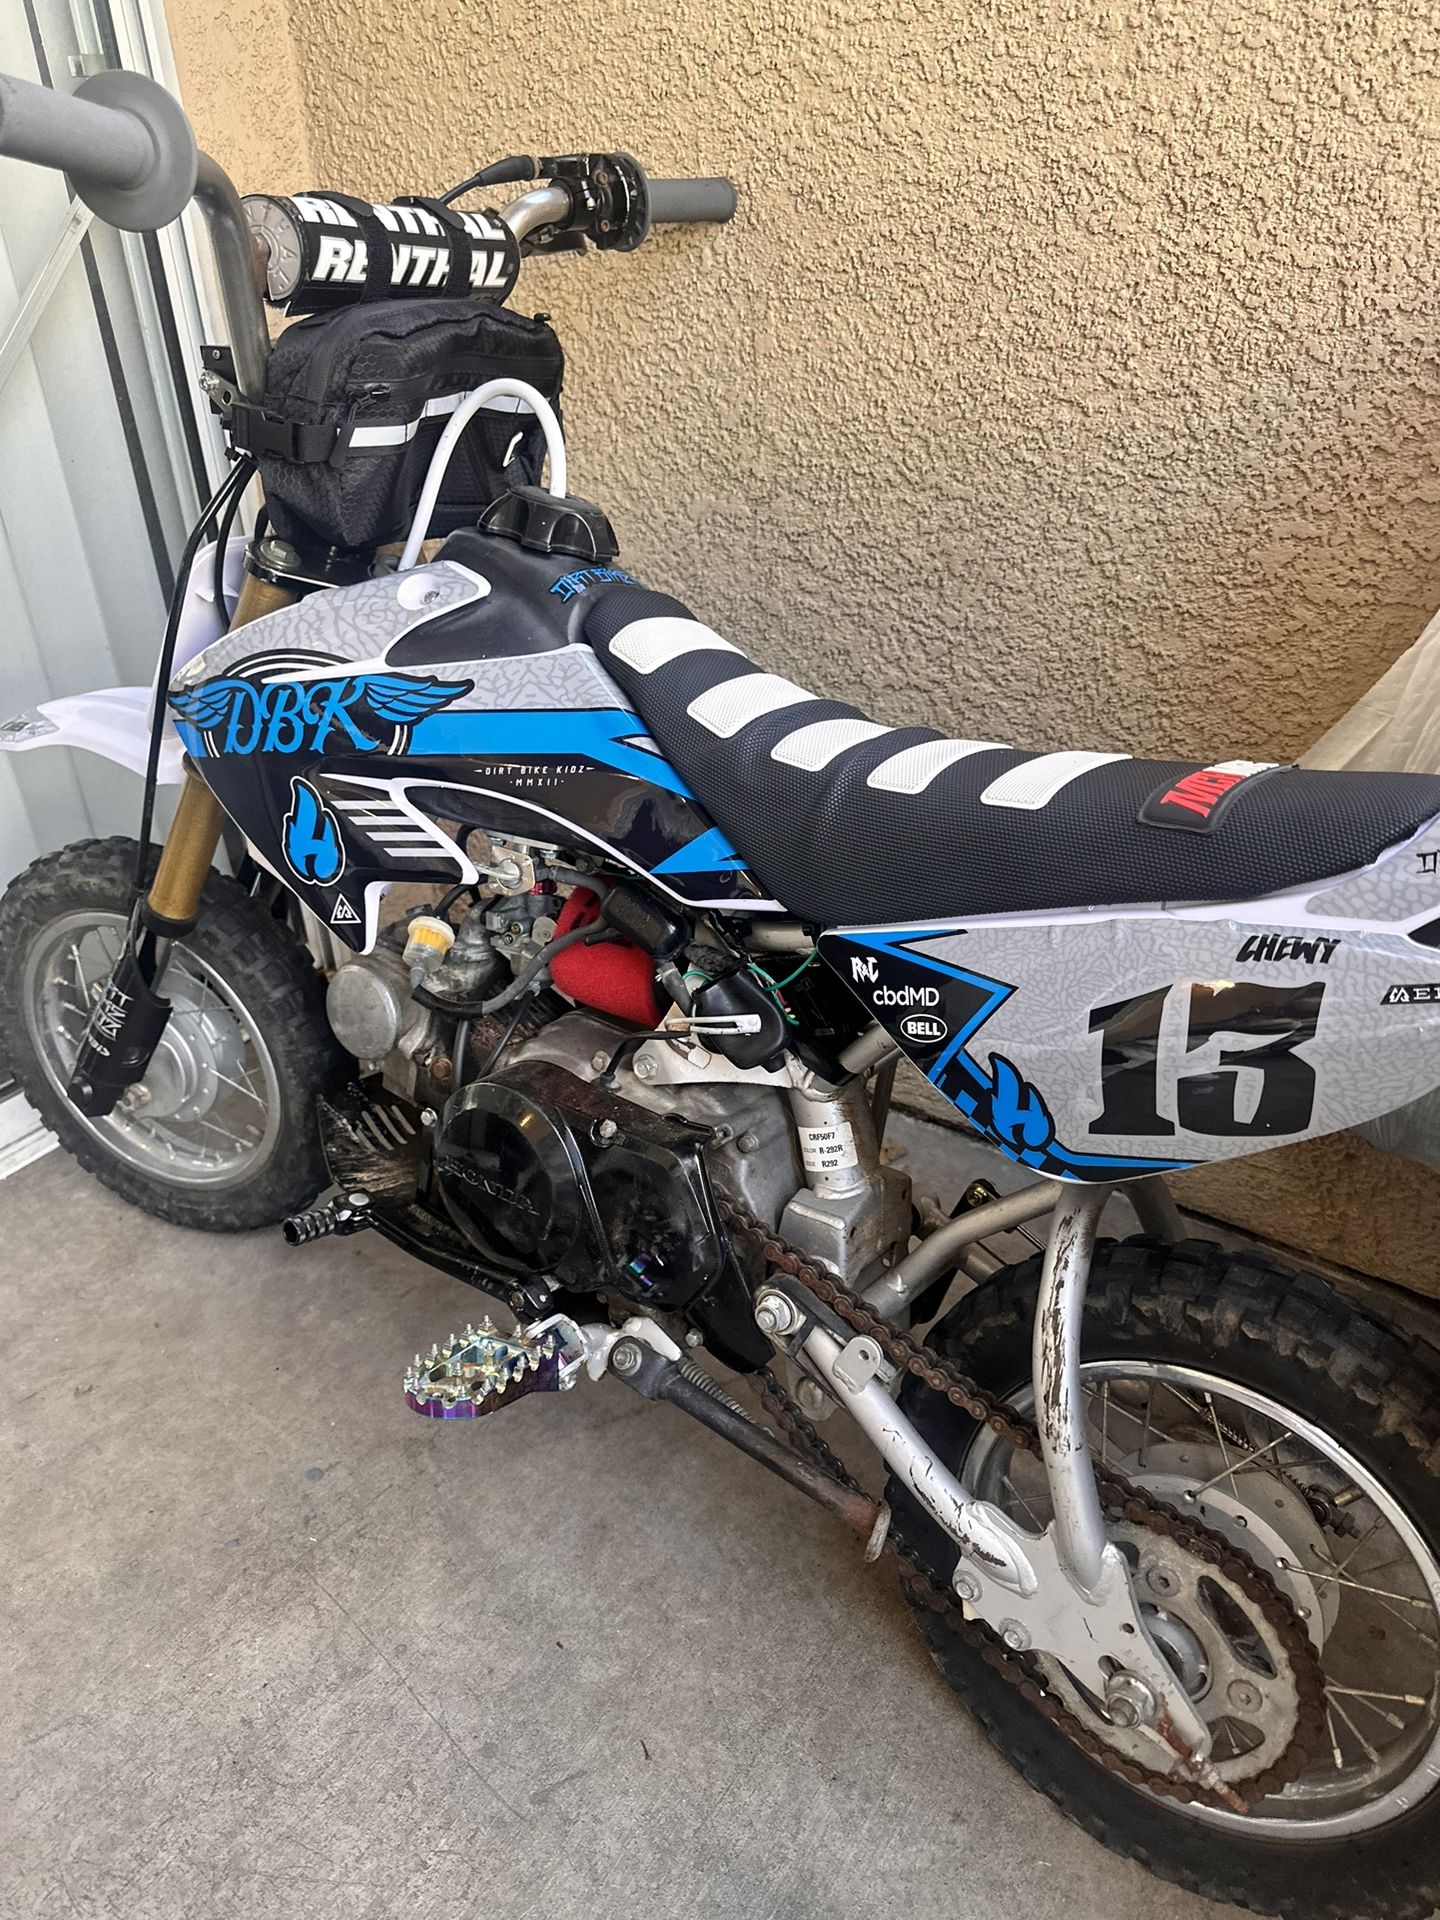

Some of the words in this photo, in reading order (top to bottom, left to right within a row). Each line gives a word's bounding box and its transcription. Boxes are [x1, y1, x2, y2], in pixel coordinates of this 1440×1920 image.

[222, 674, 382, 755] DBK
[485, 767, 512, 775] DIRT
[520, 766, 548, 774] BIKE
[556, 765, 585, 774] KIDZ
[1235, 933, 1342, 965] CHEWY
[872, 985, 940, 1007] cbdMD
[906, 1021, 942, 1036] BELL
[808, 1132, 835, 1141] CRF50F7
